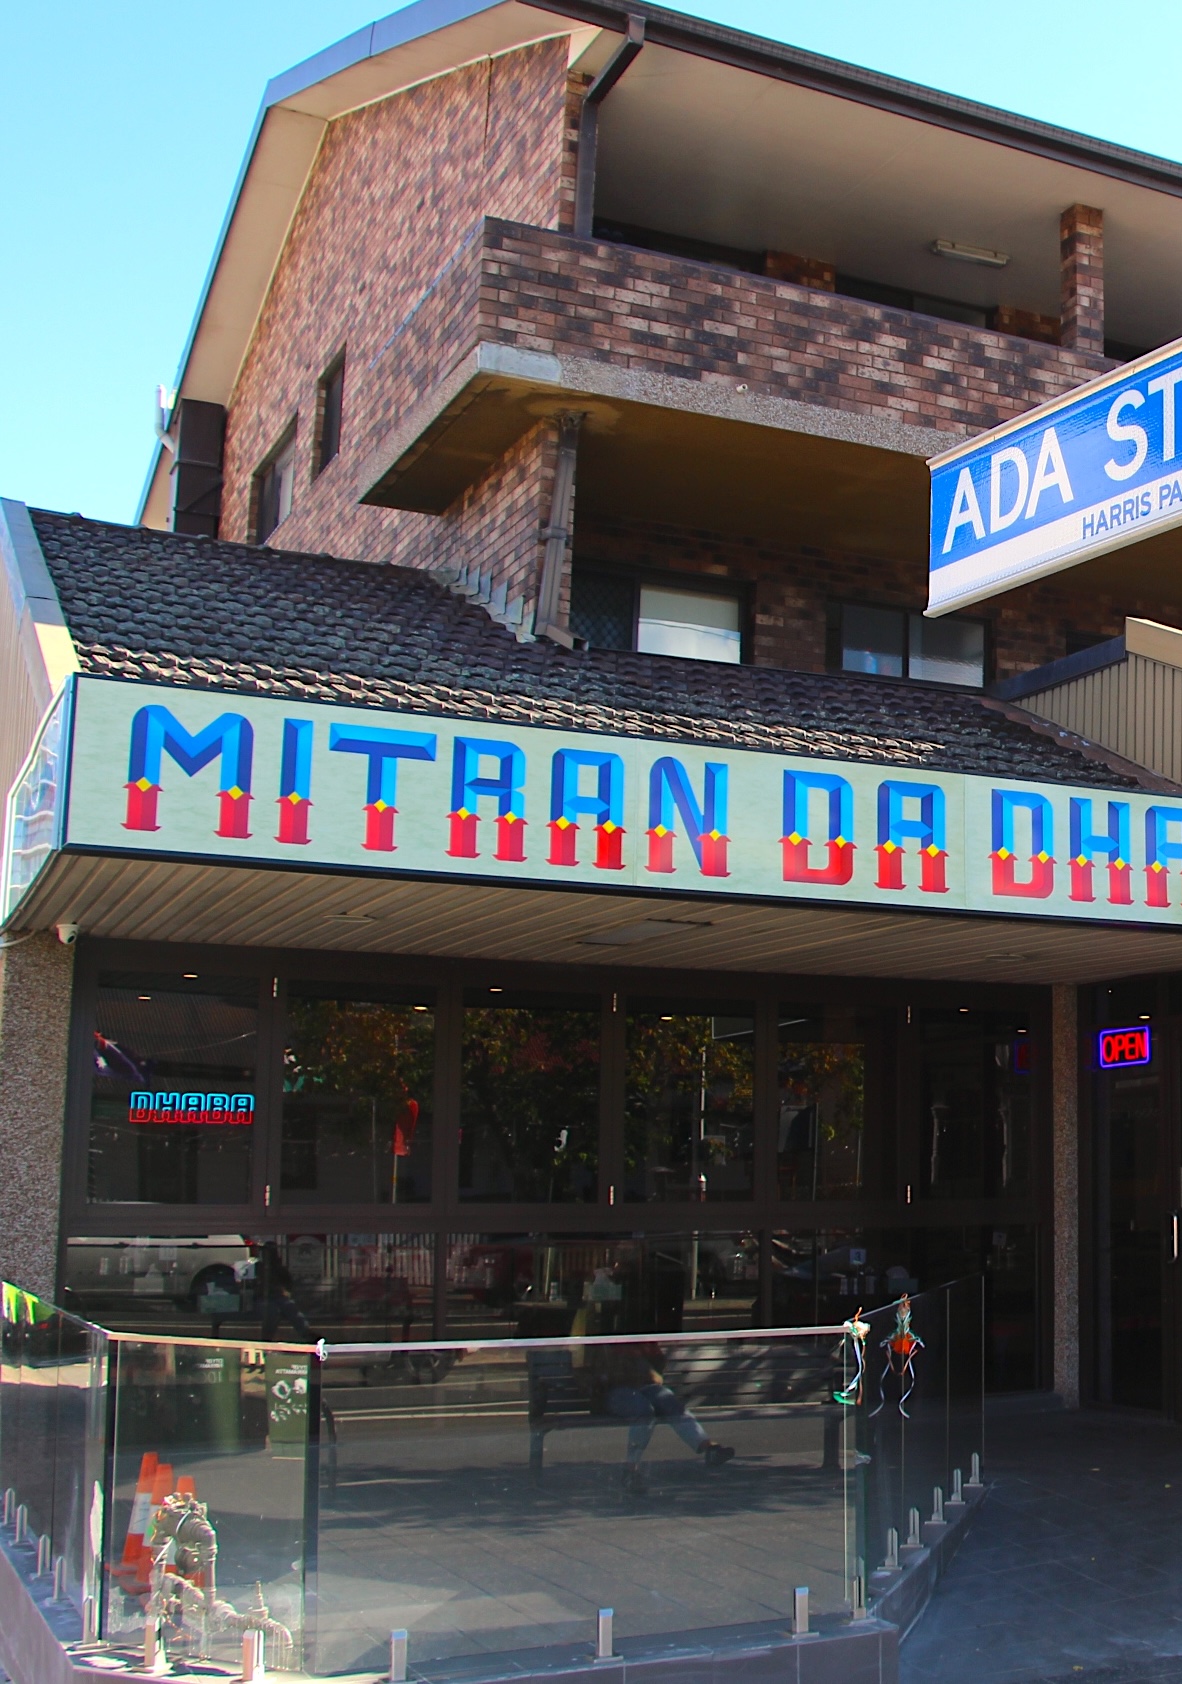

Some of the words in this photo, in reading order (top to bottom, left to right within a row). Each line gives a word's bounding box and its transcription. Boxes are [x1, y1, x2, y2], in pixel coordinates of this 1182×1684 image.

[942, 428, 1074, 555] ADA
[1081, 491, 1152, 540] HARRIS
[120, 704, 731, 878] MITRAN
[781, 768, 951, 894] DA
[1102, 1031, 1149, 1063] OPEN
[129, 1091, 255, 1124] DHABA
